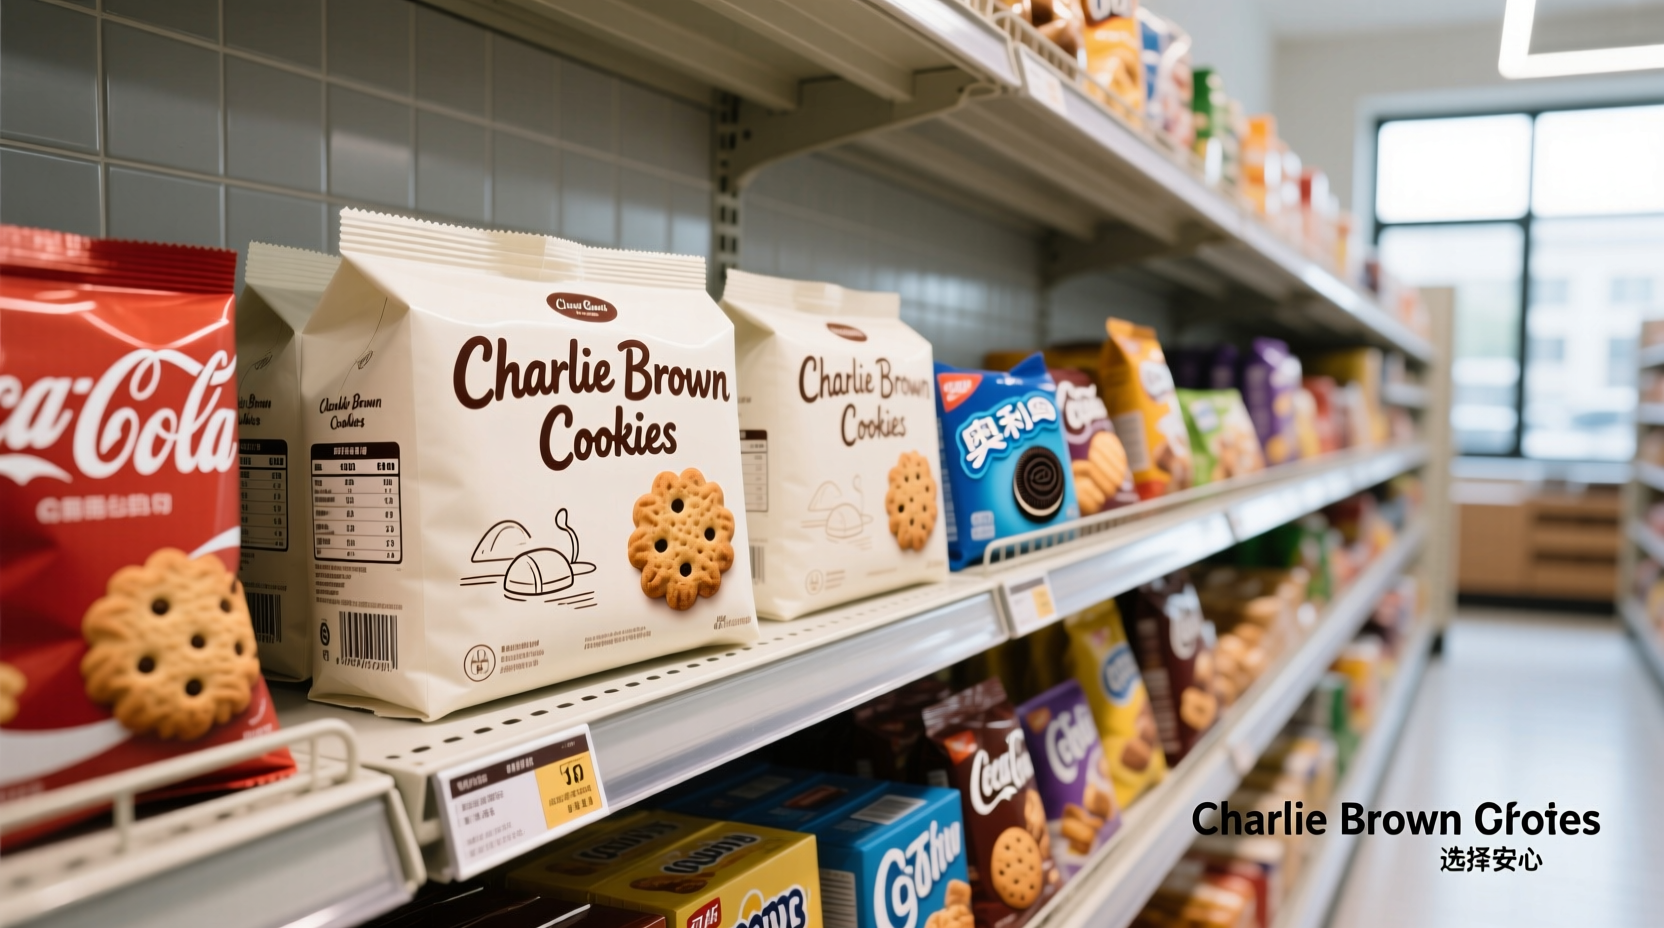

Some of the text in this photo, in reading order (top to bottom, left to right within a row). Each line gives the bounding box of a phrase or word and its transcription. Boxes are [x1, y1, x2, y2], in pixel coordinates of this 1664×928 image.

[453, 335, 730, 410] Charlie Brown
[799, 355, 874, 403] Charlie
[875, 357, 930, 399] Brown
[539, 404, 677, 471] Cookies
[841, 403, 906, 447] Cookies
